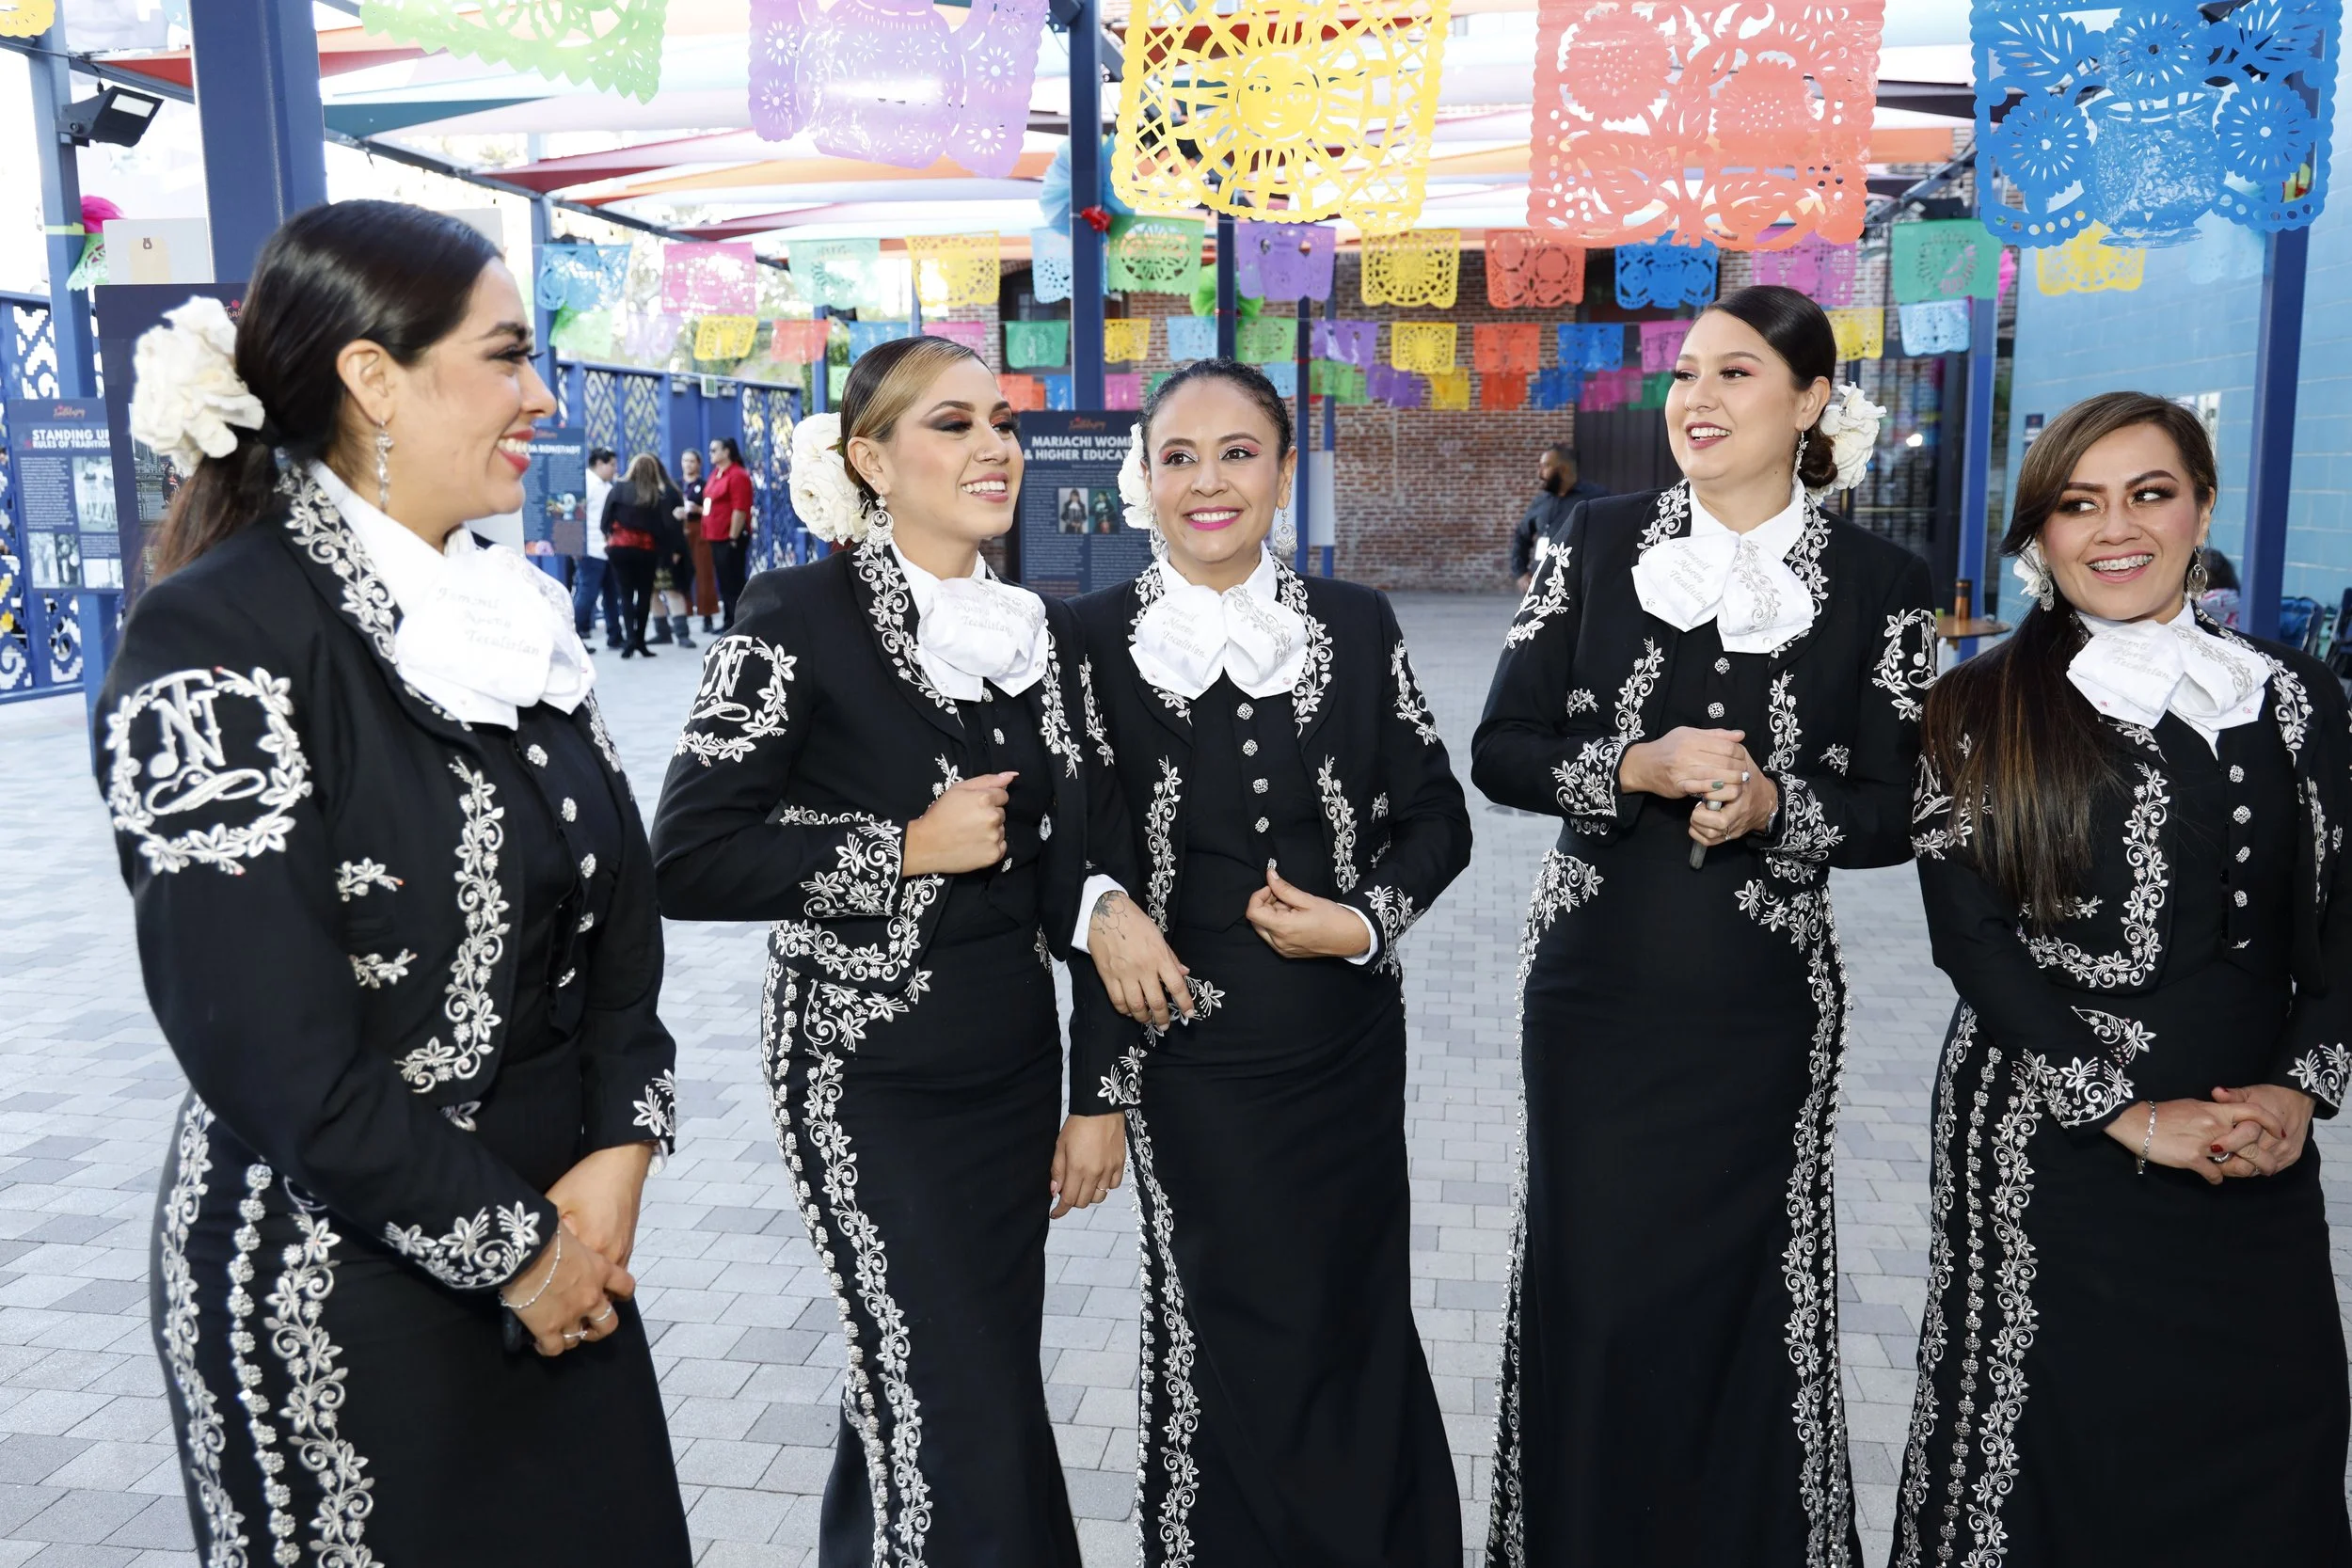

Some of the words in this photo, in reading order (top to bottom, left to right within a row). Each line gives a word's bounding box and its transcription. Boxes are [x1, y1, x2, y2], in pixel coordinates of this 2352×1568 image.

[32, 429, 93, 441] STANDING
[32, 440, 56, 449] RULES
[58, 440, 69, 449] OF
[1032, 436, 1091, 448] MARIACHI
[1094, 436, 1133, 448] WOME
[1024, 449, 1033, 461] &
[1036, 449, 1080, 461] HIGHER
[1083, 449, 1129, 461] EDUCAT
